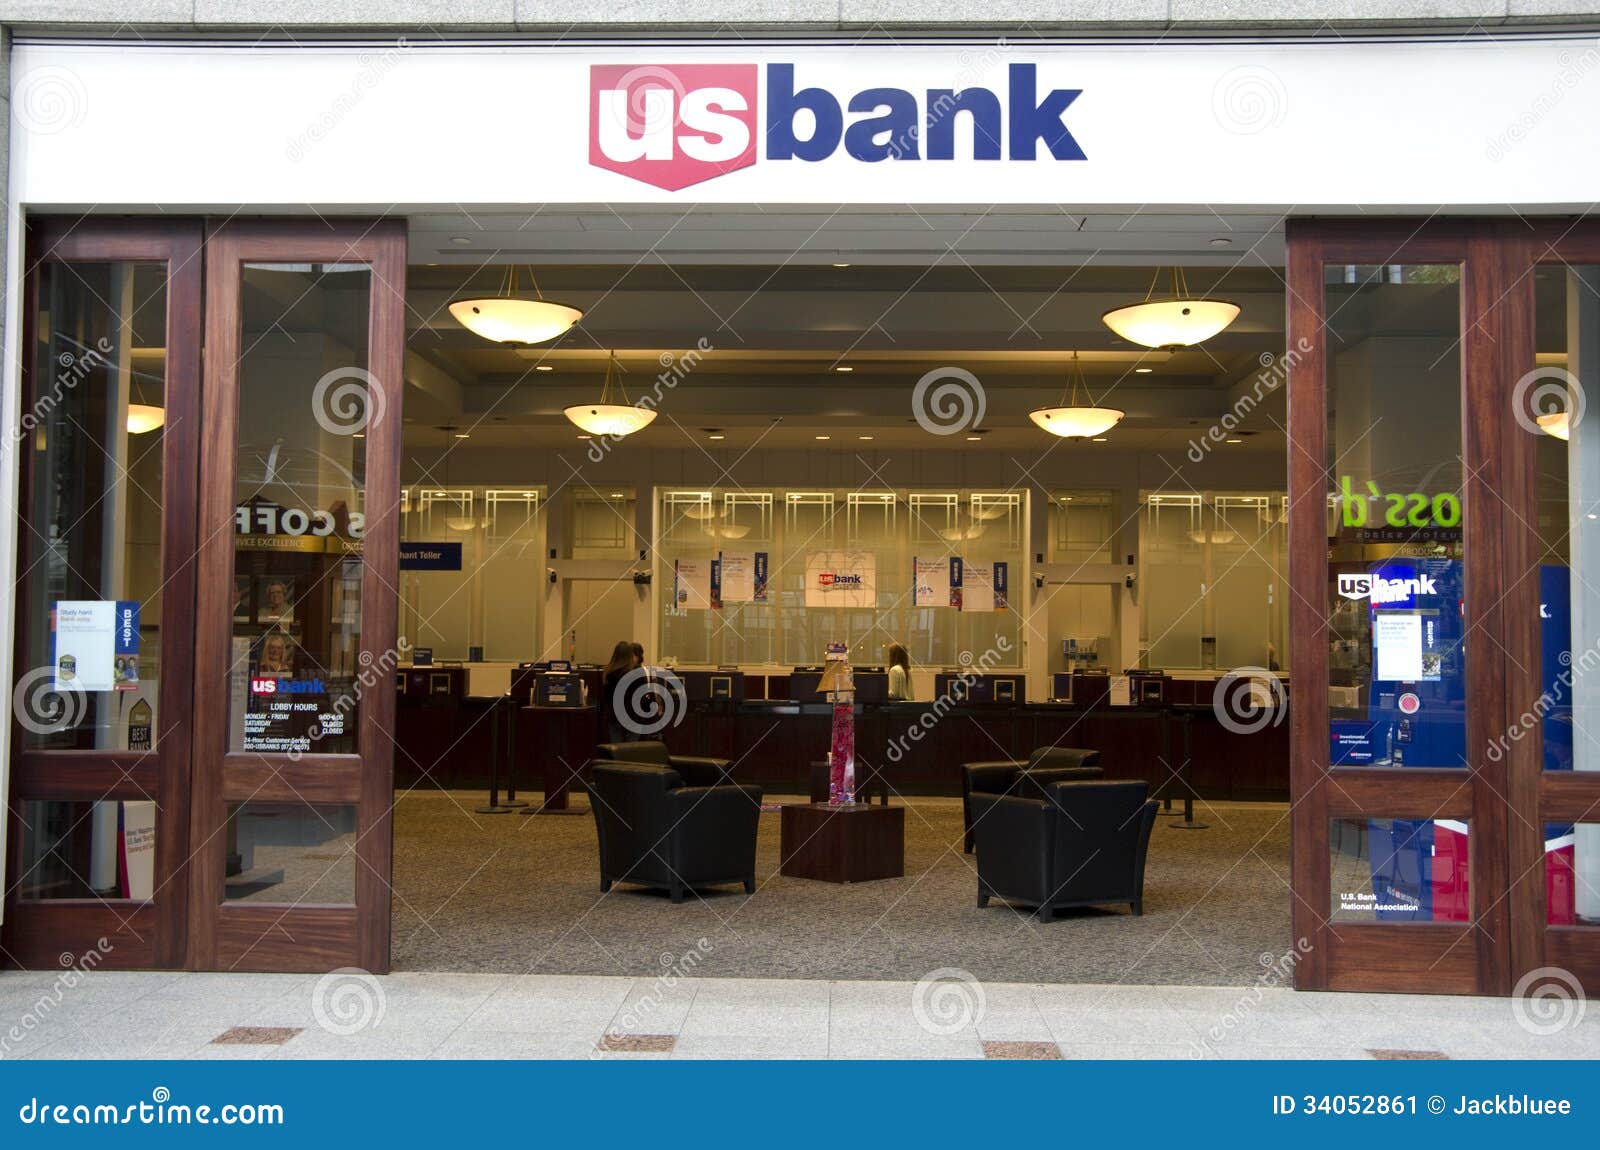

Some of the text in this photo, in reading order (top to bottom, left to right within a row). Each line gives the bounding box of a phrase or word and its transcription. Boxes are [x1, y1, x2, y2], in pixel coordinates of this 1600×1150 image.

[419, 551, 442, 560] Teller
[123, 609, 132, 647] BEST
[270, 703, 318, 711] LOBBY HOURS
[1357, 893, 1378, 901] Bank
[1340, 902, 1418, 911] National Association
